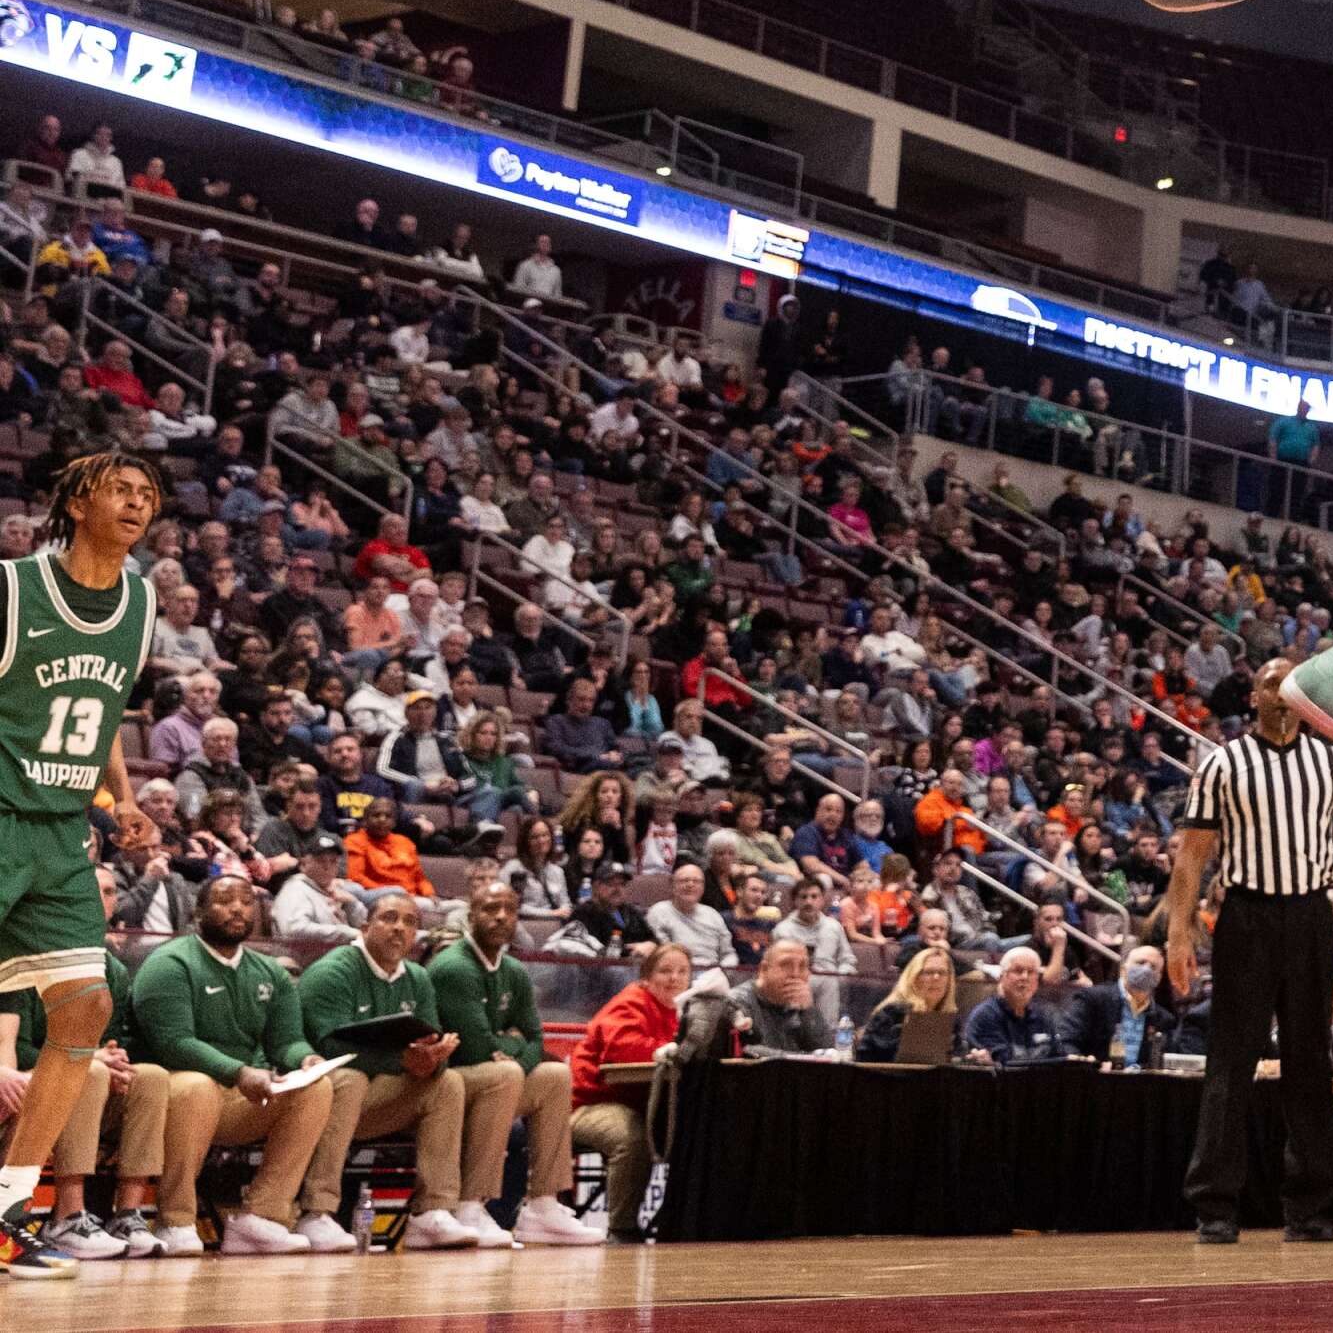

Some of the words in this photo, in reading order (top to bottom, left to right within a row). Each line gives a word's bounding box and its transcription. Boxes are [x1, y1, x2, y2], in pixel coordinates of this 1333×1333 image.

[45, 13, 117, 79] VS
[1084, 316, 1216, 389] DISTRICT
[35, 654, 127, 693] CENTRAL
[38, 696, 104, 756] 13
